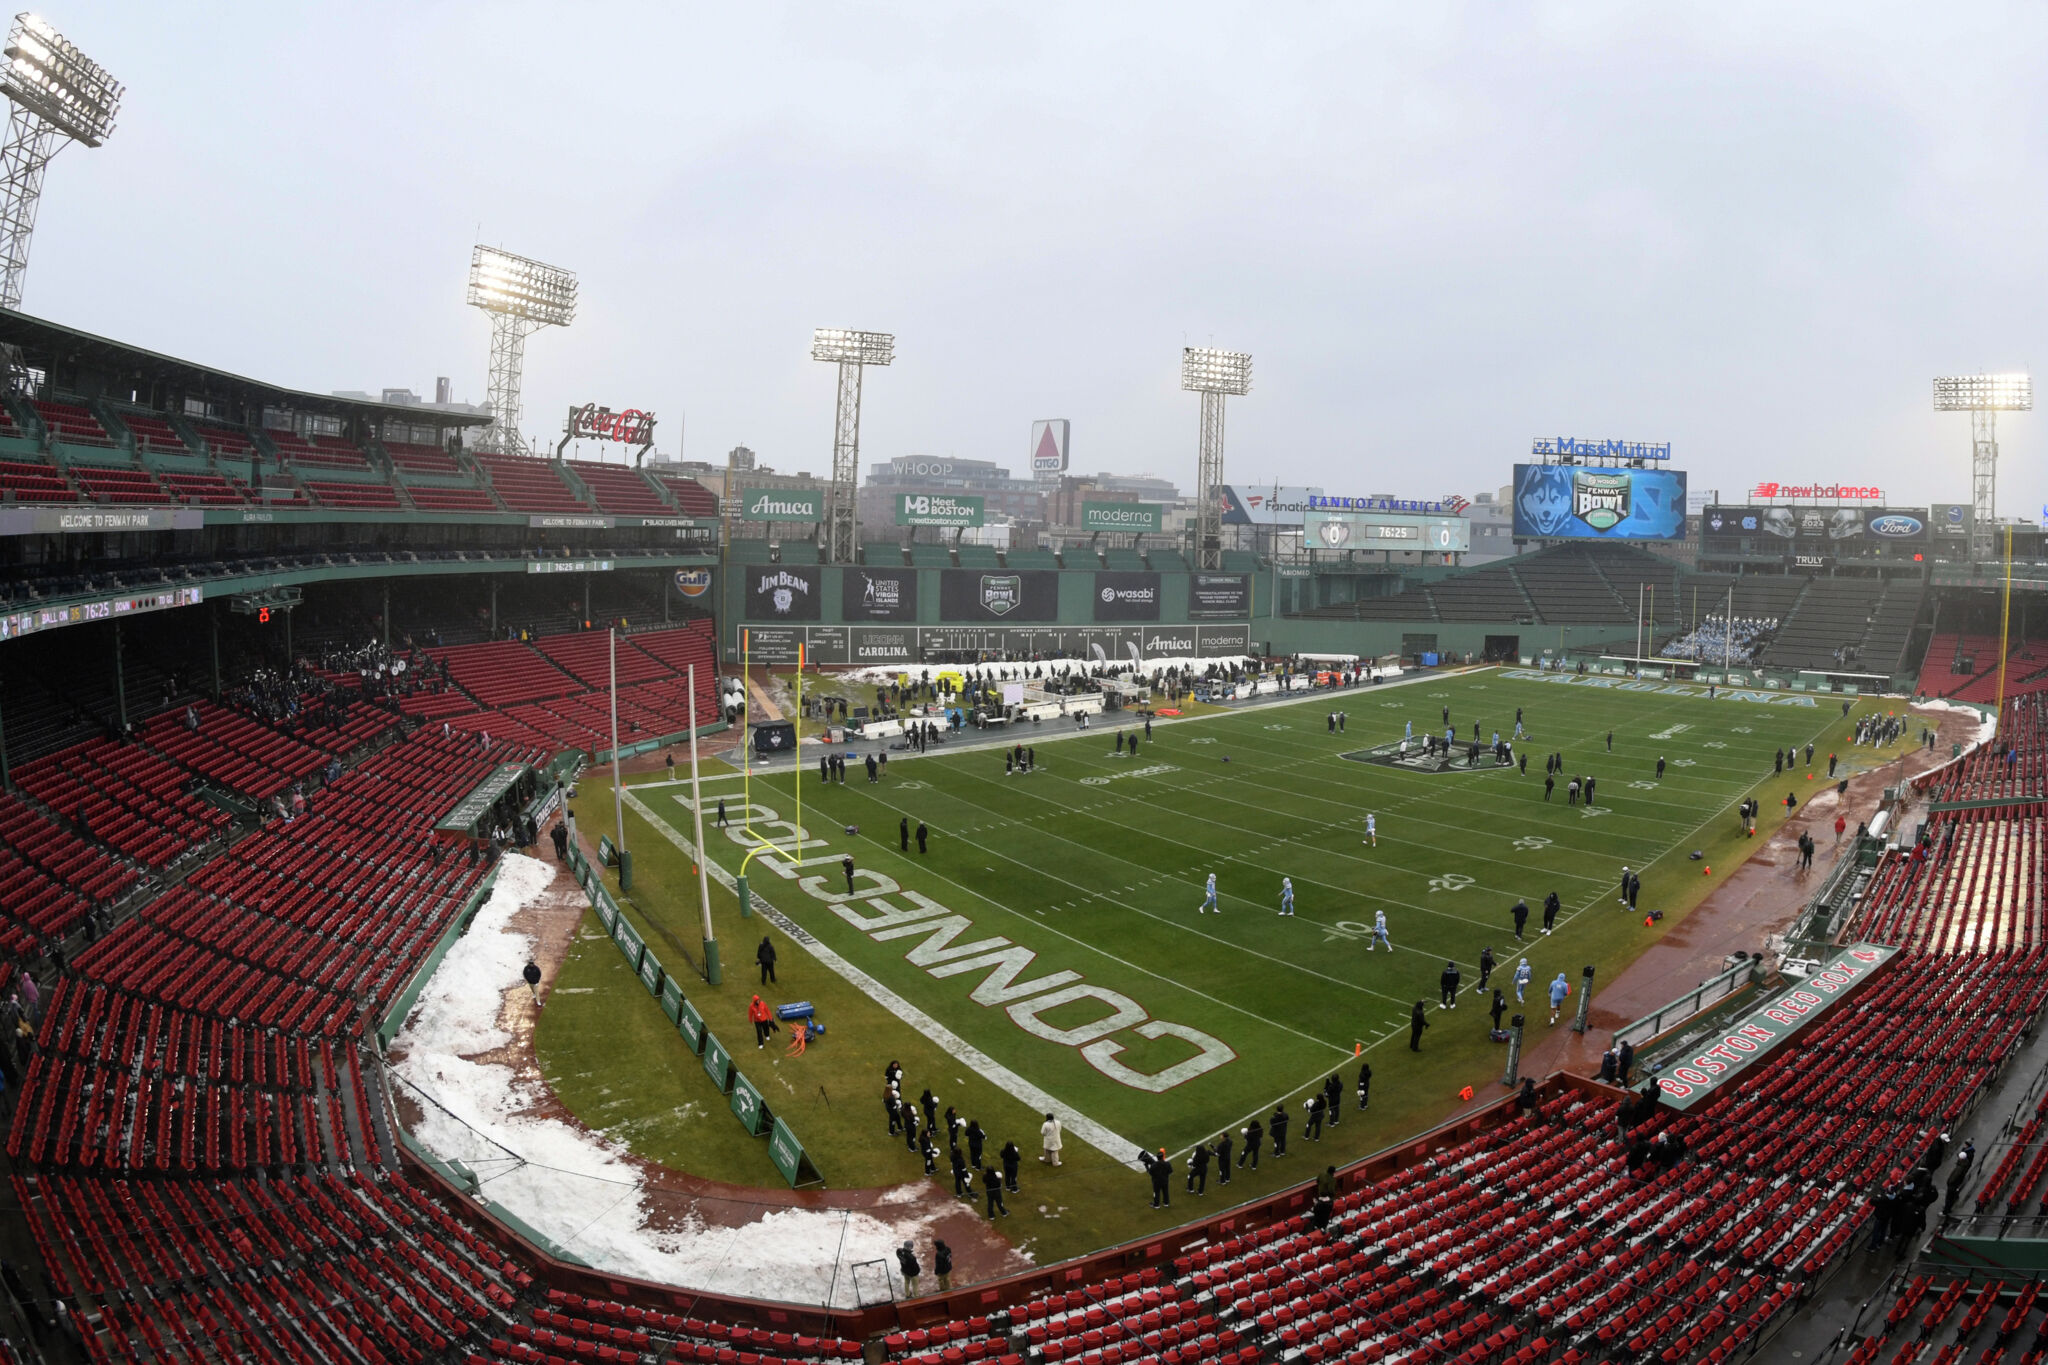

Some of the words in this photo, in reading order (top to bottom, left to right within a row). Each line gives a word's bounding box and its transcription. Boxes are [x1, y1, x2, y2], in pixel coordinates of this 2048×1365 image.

[1557, 436, 1670, 460] MassMutual
[892, 462, 953, 476] WHOOP
[1034, 458, 1059, 468] CITGO
[1587, 487, 1621, 495] FENWAY
[751, 495, 813, 515] Amica
[931, 497, 956, 506] Meet
[1309, 495, 1351, 508] BANK
[1356, 498, 1373, 509] OF
[1378, 499, 1441, 512] AMERICA
[1578, 493, 1627, 516] BOWL
[931, 506, 974, 516] BOSTON
[1089, 508, 1152, 522] moderna
[60, 515, 92, 528] WELCOME
[95, 514, 103, 527] TO
[105, 514, 131, 527] FENWAY
[132, 514, 149, 527] PARK
[542, 518, 565, 526] WELCOME
[908, 517, 970, 526] meetboston.com
[1880, 519, 1912, 534] Ford
[1330, 526, 1339, 544] 0
[1379, 527, 1407, 538] 76:25
[1441, 530, 1450, 546] 0
[1796, 555, 1823, 564] TRULY
[676, 573, 708, 585] Gulf
[1282, 569, 1310, 577] ABIOMED
[758, 576, 778, 594] JIM
[779, 571, 809, 596] BEAM
[985, 590, 1016, 603] BOWL
[1116, 588, 1154, 599] wasabi
[42, 611, 57, 625] BALL
[59, 610, 68, 621] ON
[85, 601, 109, 619] 76:25
[115, 600, 130, 612] DOWN
[863, 635, 904, 645] UCONN
[1146, 636, 1192, 650] Amica
[1201, 636, 1243, 645] moderna
[858, 647, 909, 656] CAROLINA
[1497, 670, 1818, 707] CAROLINA
[1513, 836, 1552, 850] 30
[1429, 873, 1476, 891] 20
[672, 793, 1238, 1094] CONNECTICUT
[1657, 1023, 1776, 1099] BOSTON
[1764, 991, 1822, 1025] RED
[1810, 961, 1864, 993] SOX
